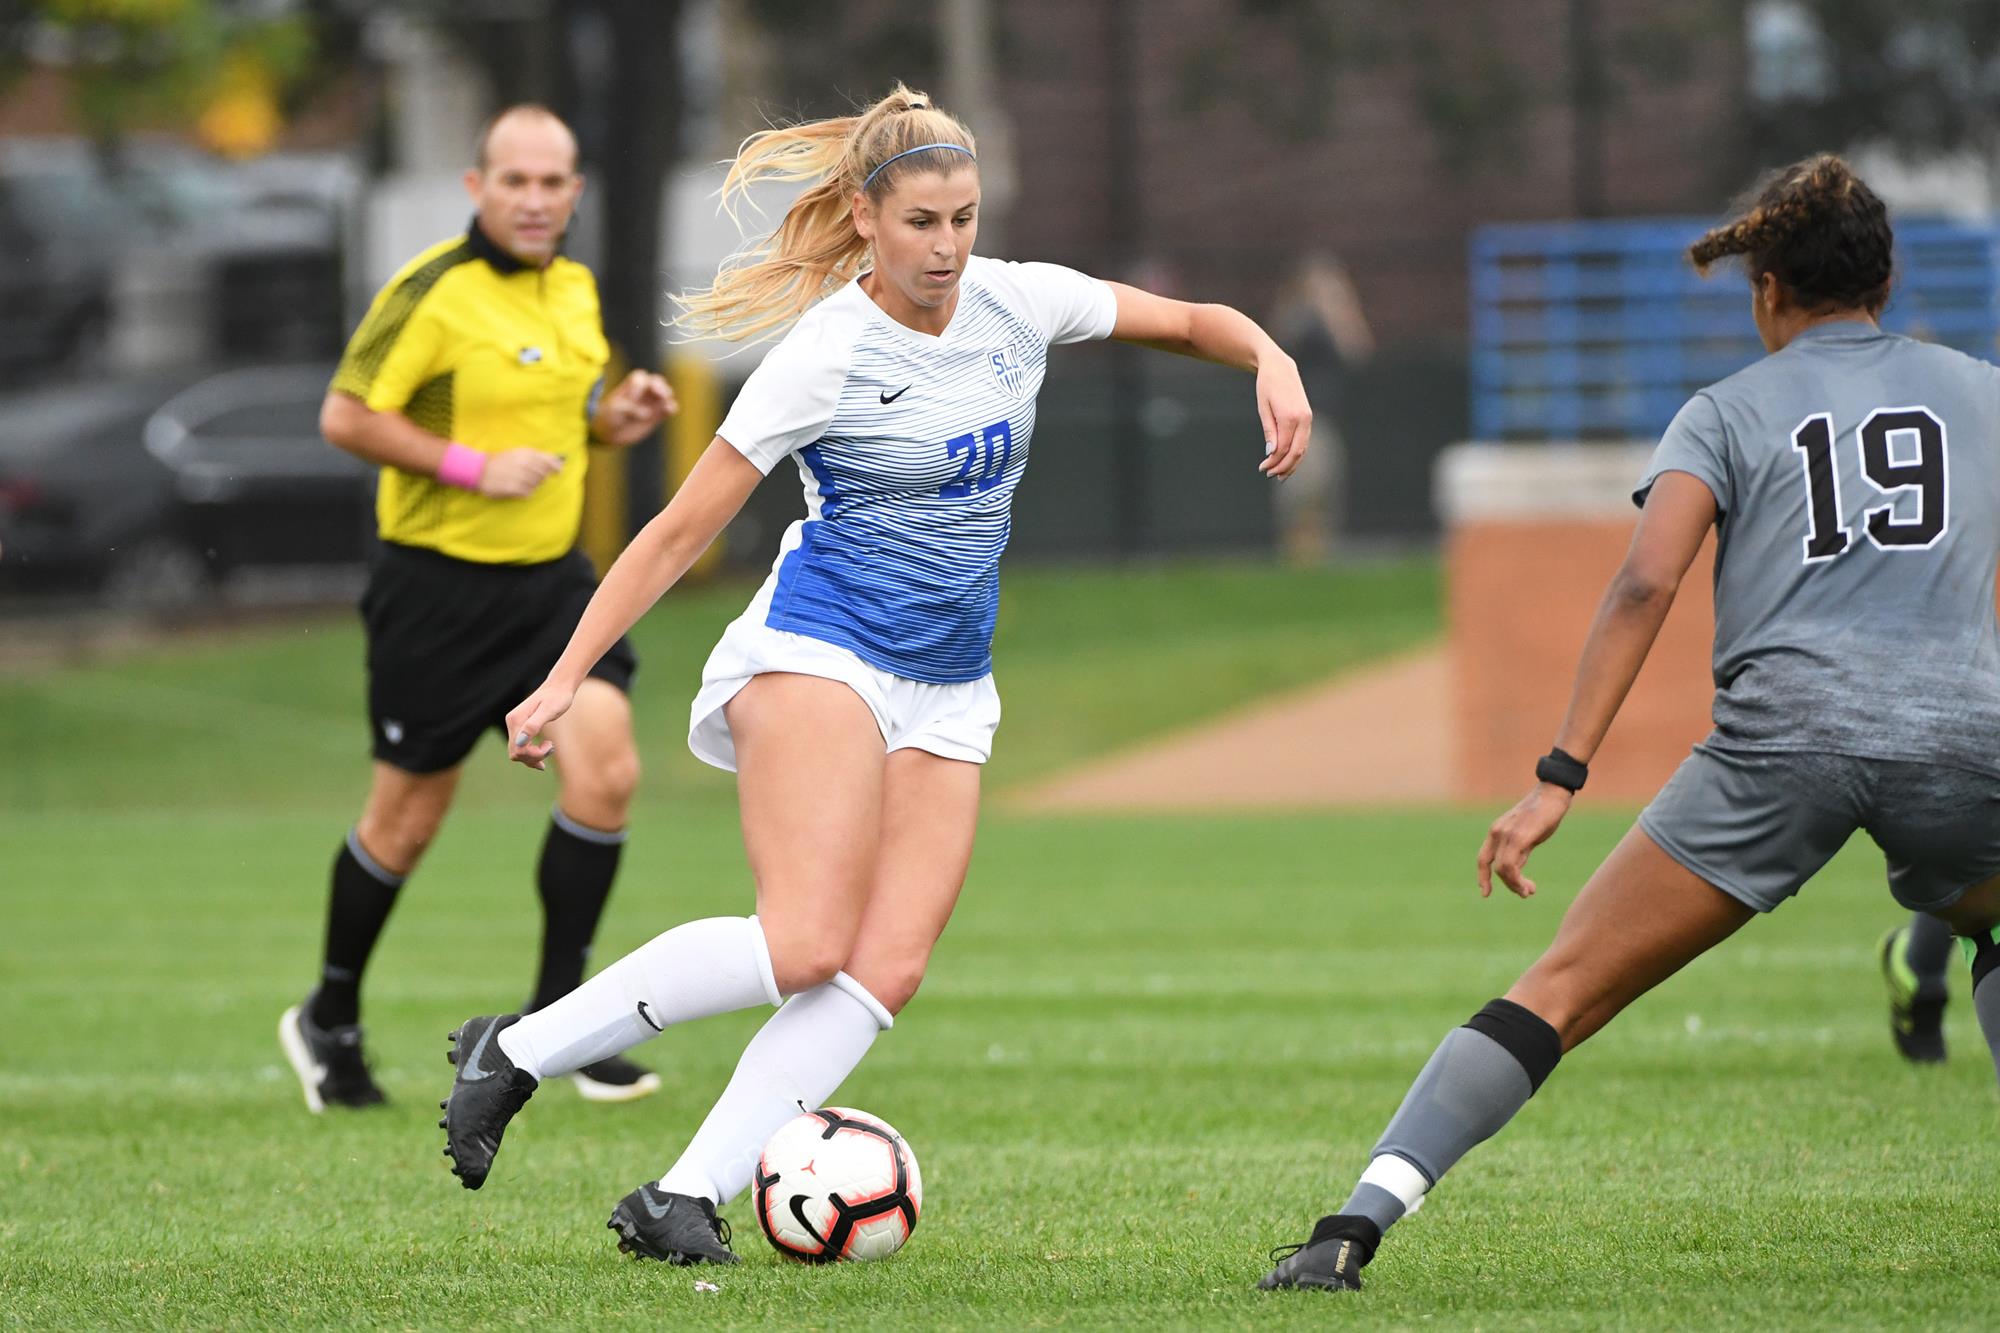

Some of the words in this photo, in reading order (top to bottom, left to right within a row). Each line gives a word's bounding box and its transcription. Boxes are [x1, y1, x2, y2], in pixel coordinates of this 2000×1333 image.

[992, 349, 1019, 376] SLU
[939, 419, 1012, 498] 20
[1791, 405, 1949, 565] 19
